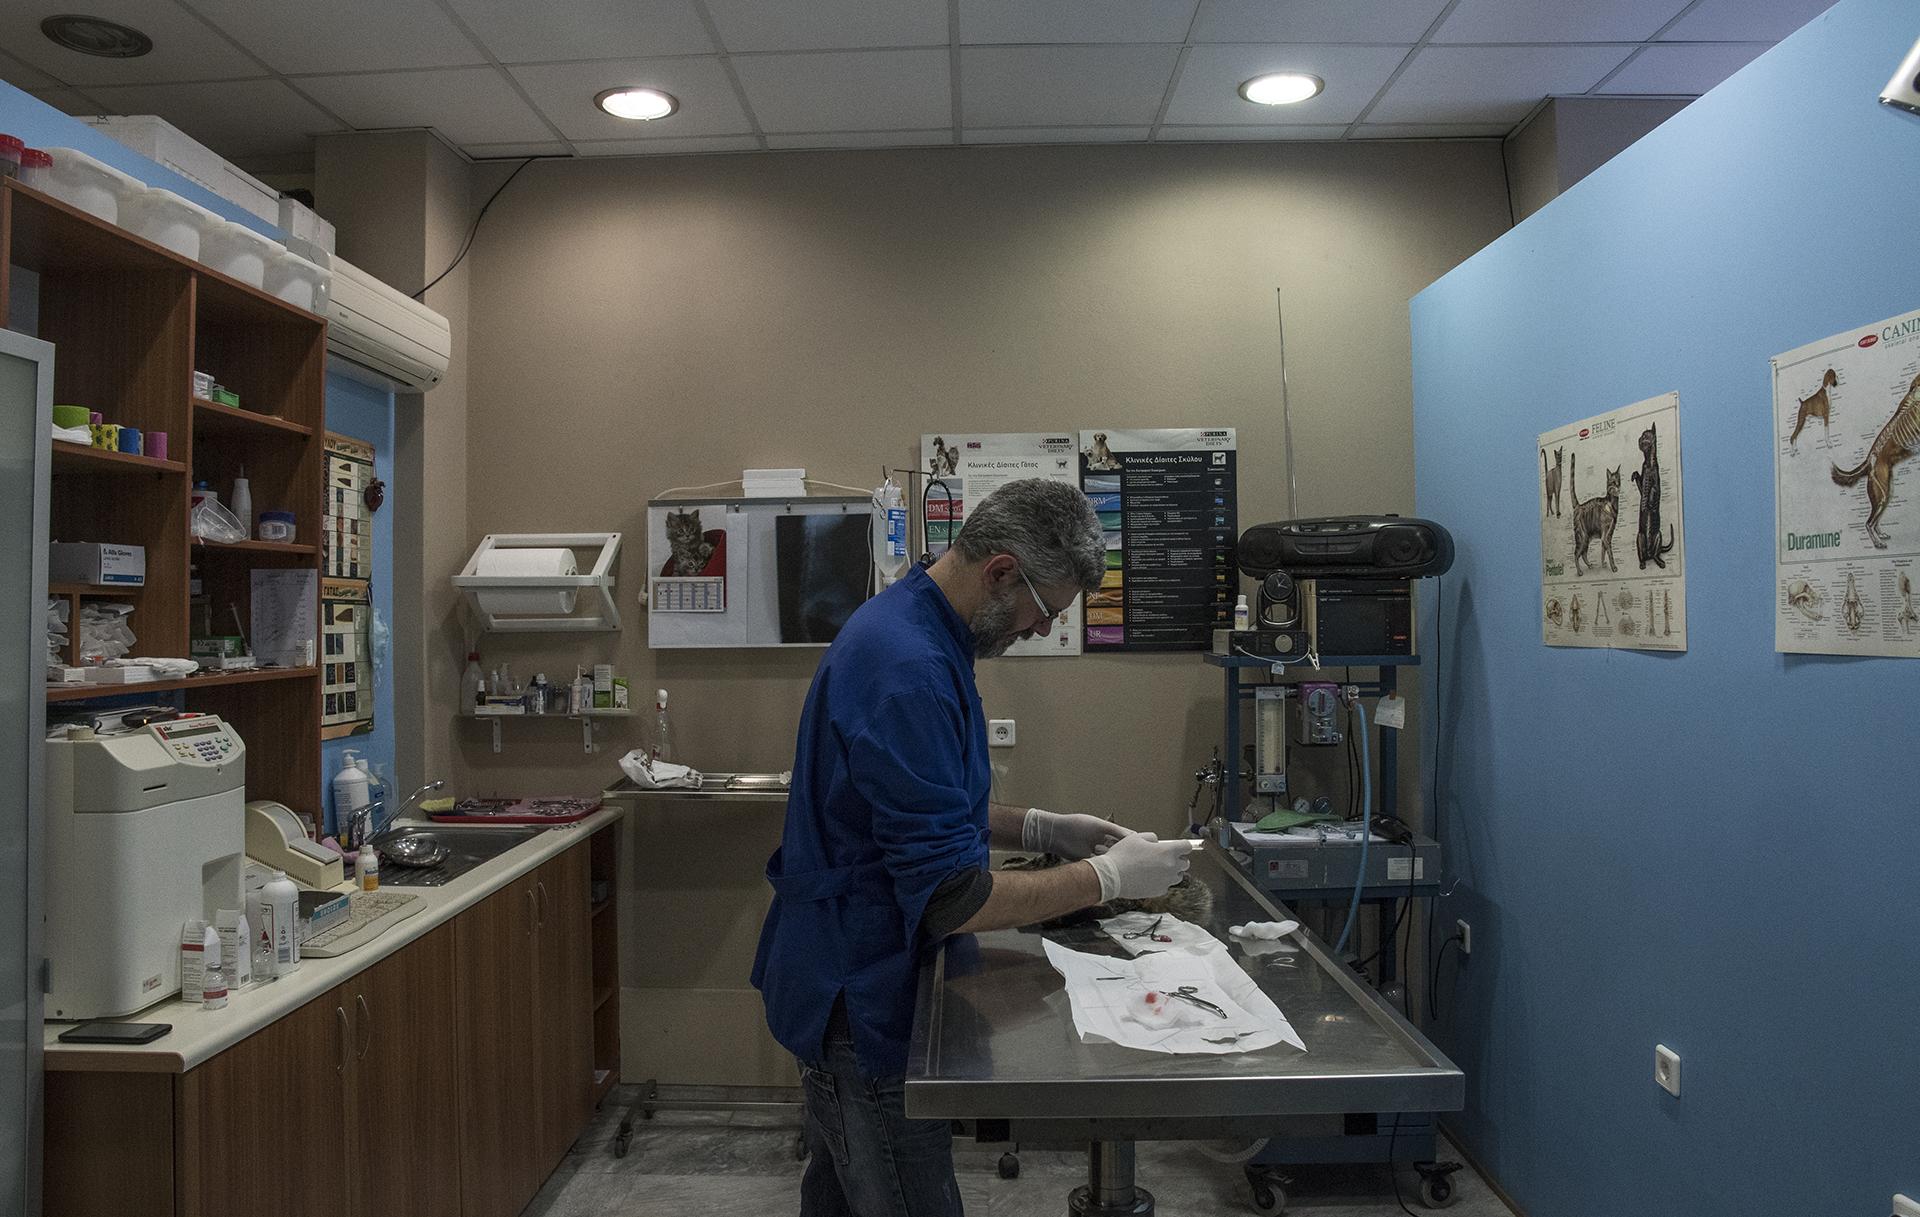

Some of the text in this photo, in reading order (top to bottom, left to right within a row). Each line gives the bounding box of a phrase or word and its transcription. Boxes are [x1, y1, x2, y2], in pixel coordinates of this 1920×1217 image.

[1592, 418, 1616, 434] FELINE
[1125, 455, 1203, 464] Κλινικές Δίαιτες Σκύλου
[968, 461, 995, 469] Κλινικές
[928, 504, 944, 513] DM
[928, 525, 941, 534] EN
[1787, 531, 1841, 551] Duramune
